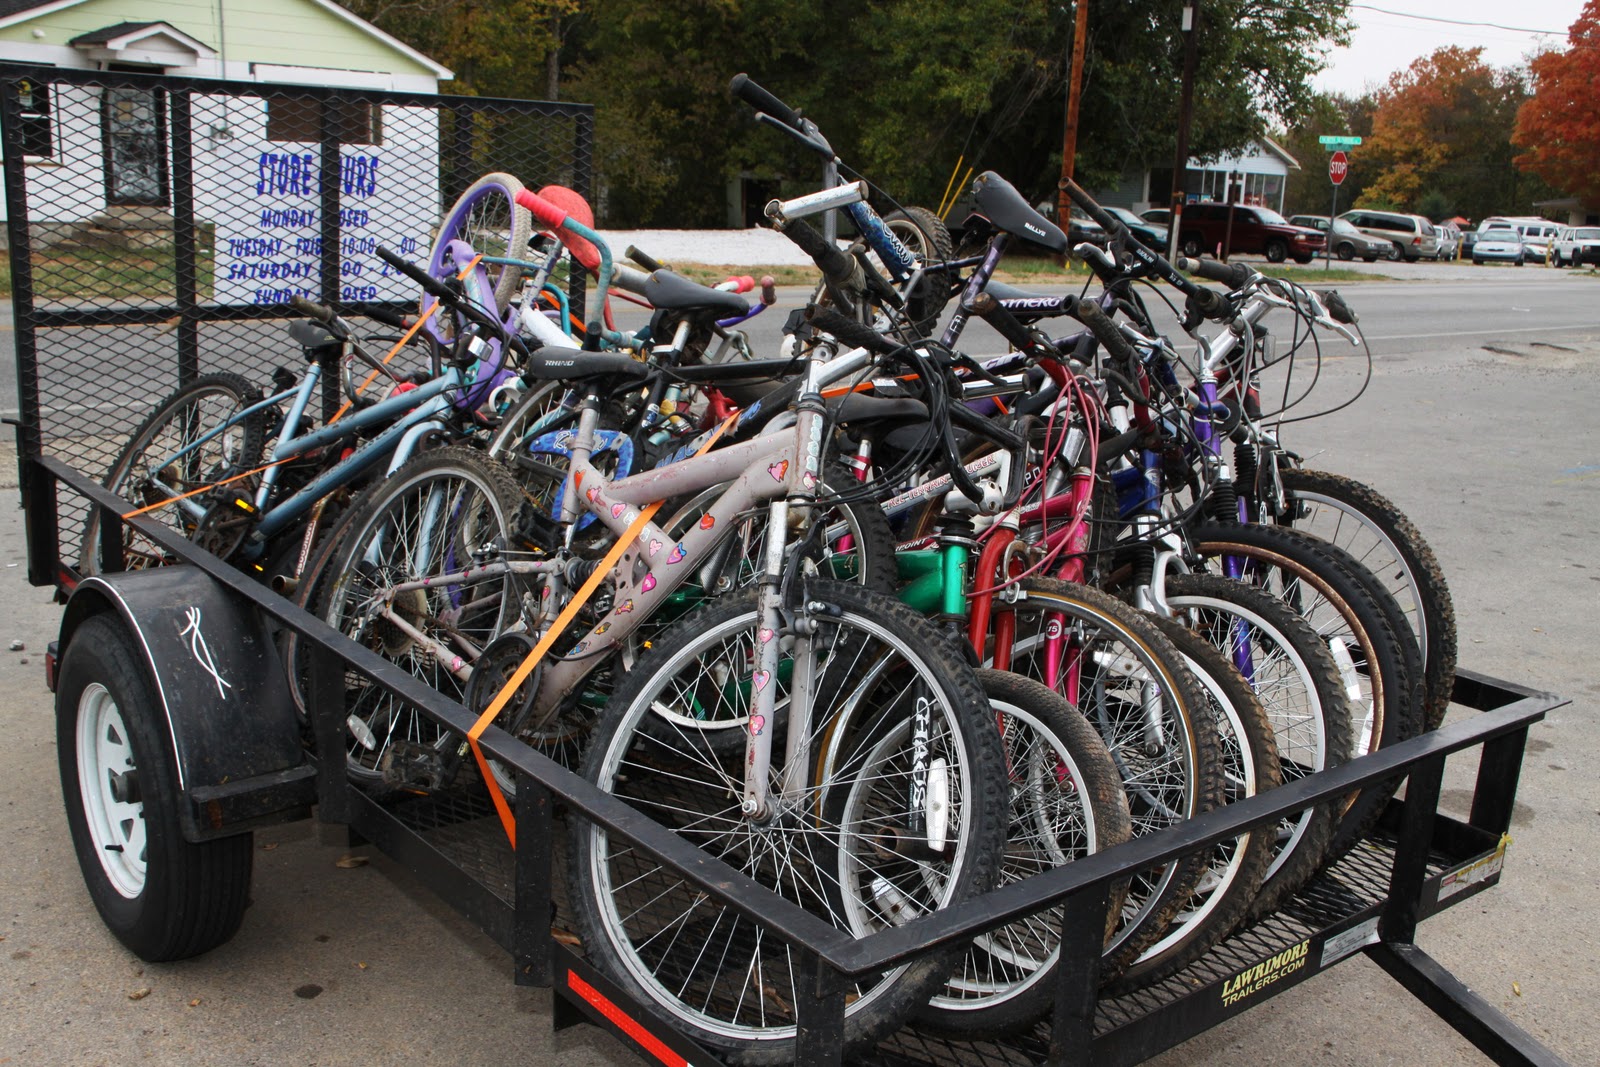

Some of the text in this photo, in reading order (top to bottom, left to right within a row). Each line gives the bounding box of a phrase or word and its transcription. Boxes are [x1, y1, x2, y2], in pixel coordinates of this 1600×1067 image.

[257, 153, 313, 198] STORE
[1330, 162, 1346, 174] STOP
[260, 209, 314, 228] MONDAY
[228, 238, 282, 257] TUESDAY
[295, 237, 323, 256] FRID
[228, 261, 312, 280] SATURDAY
[908, 476, 949, 500] TERRAIN
[965, 455, 997, 473] UISER
[912, 696, 929, 814] CHAOS
[1221, 939, 1310, 998] LAWRIMORE
[1222, 958, 1305, 1008] TRAILERS.COM
